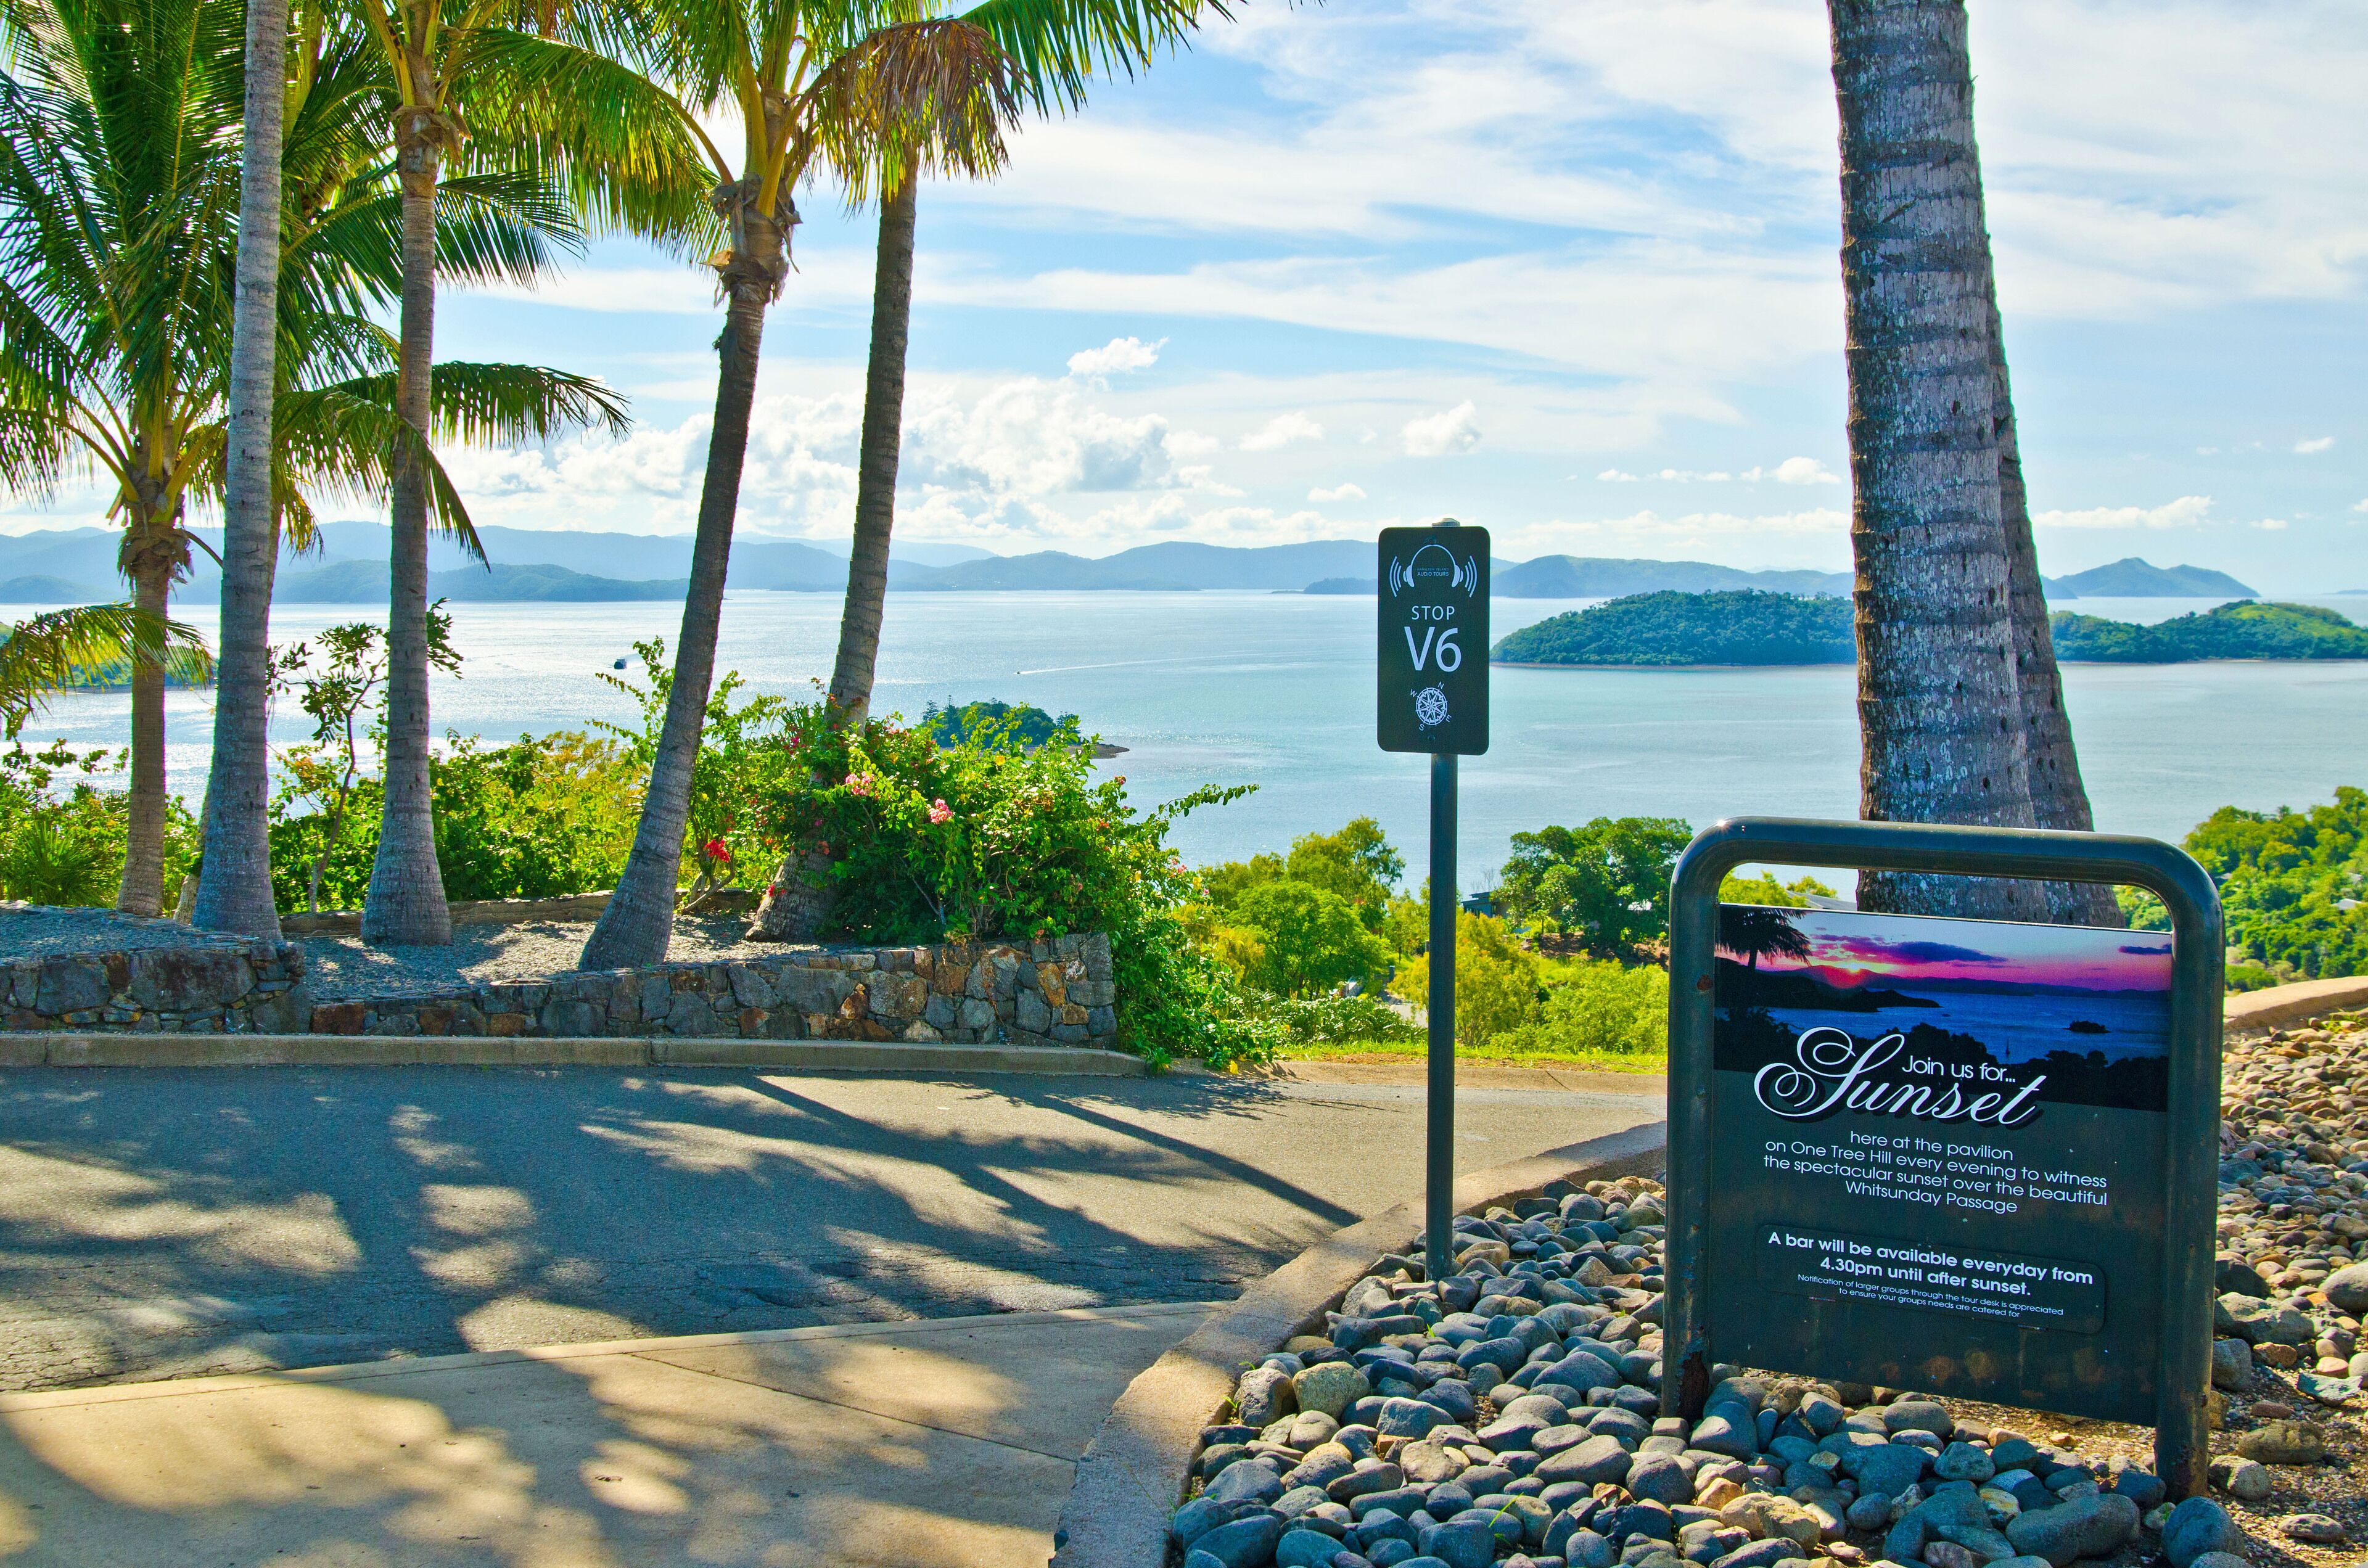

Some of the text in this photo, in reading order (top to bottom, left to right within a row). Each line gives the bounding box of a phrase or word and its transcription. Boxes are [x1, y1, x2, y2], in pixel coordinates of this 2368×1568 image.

[1412, 605, 1455, 620] STOP
[1404, 626, 1462, 672] V6
[1410, 689, 1417, 697] W
[1437, 681, 1444, 689] N
[1418, 723, 1425, 731] S
[1445, 715, 1452, 723] E
[1754, 1027, 2047, 1125] Sunset
[1902, 1055, 2015, 1083] Join us for...
[1850, 1130, 2013, 1160] here at the pavilion
[1763, 1154, 2107, 1205] the spectacular sunset over the beautiful
[1766, 1141, 2107, 1188] on One Tree Hill every evening to witness
[1845, 1180, 2018, 1215] Whitsunday Passage
[1768, 1231, 2093, 1284] A bar will be available everyday from
[1820, 1257, 2031, 1295] 4.30pm until after sunset.
[1798, 1274, 1844, 1286] Notification
[1856, 1281, 1880, 1291] larger
[1881, 1286, 1909, 1295] groups
[1911, 1289, 1944, 1300] through
[1945, 1293, 1959, 1302] the
[1961, 1295, 1978, 1304] tour
[1980, 1299, 2000, 1307] desk
[2008, 1303, 2063, 1315] appreciated
[1849, 1290, 1877, 1299] ensure
[1898, 1296, 1926, 1305] groups
[1928, 1300, 1954, 1309] needs
[1972, 1307, 2007, 1316] catered
